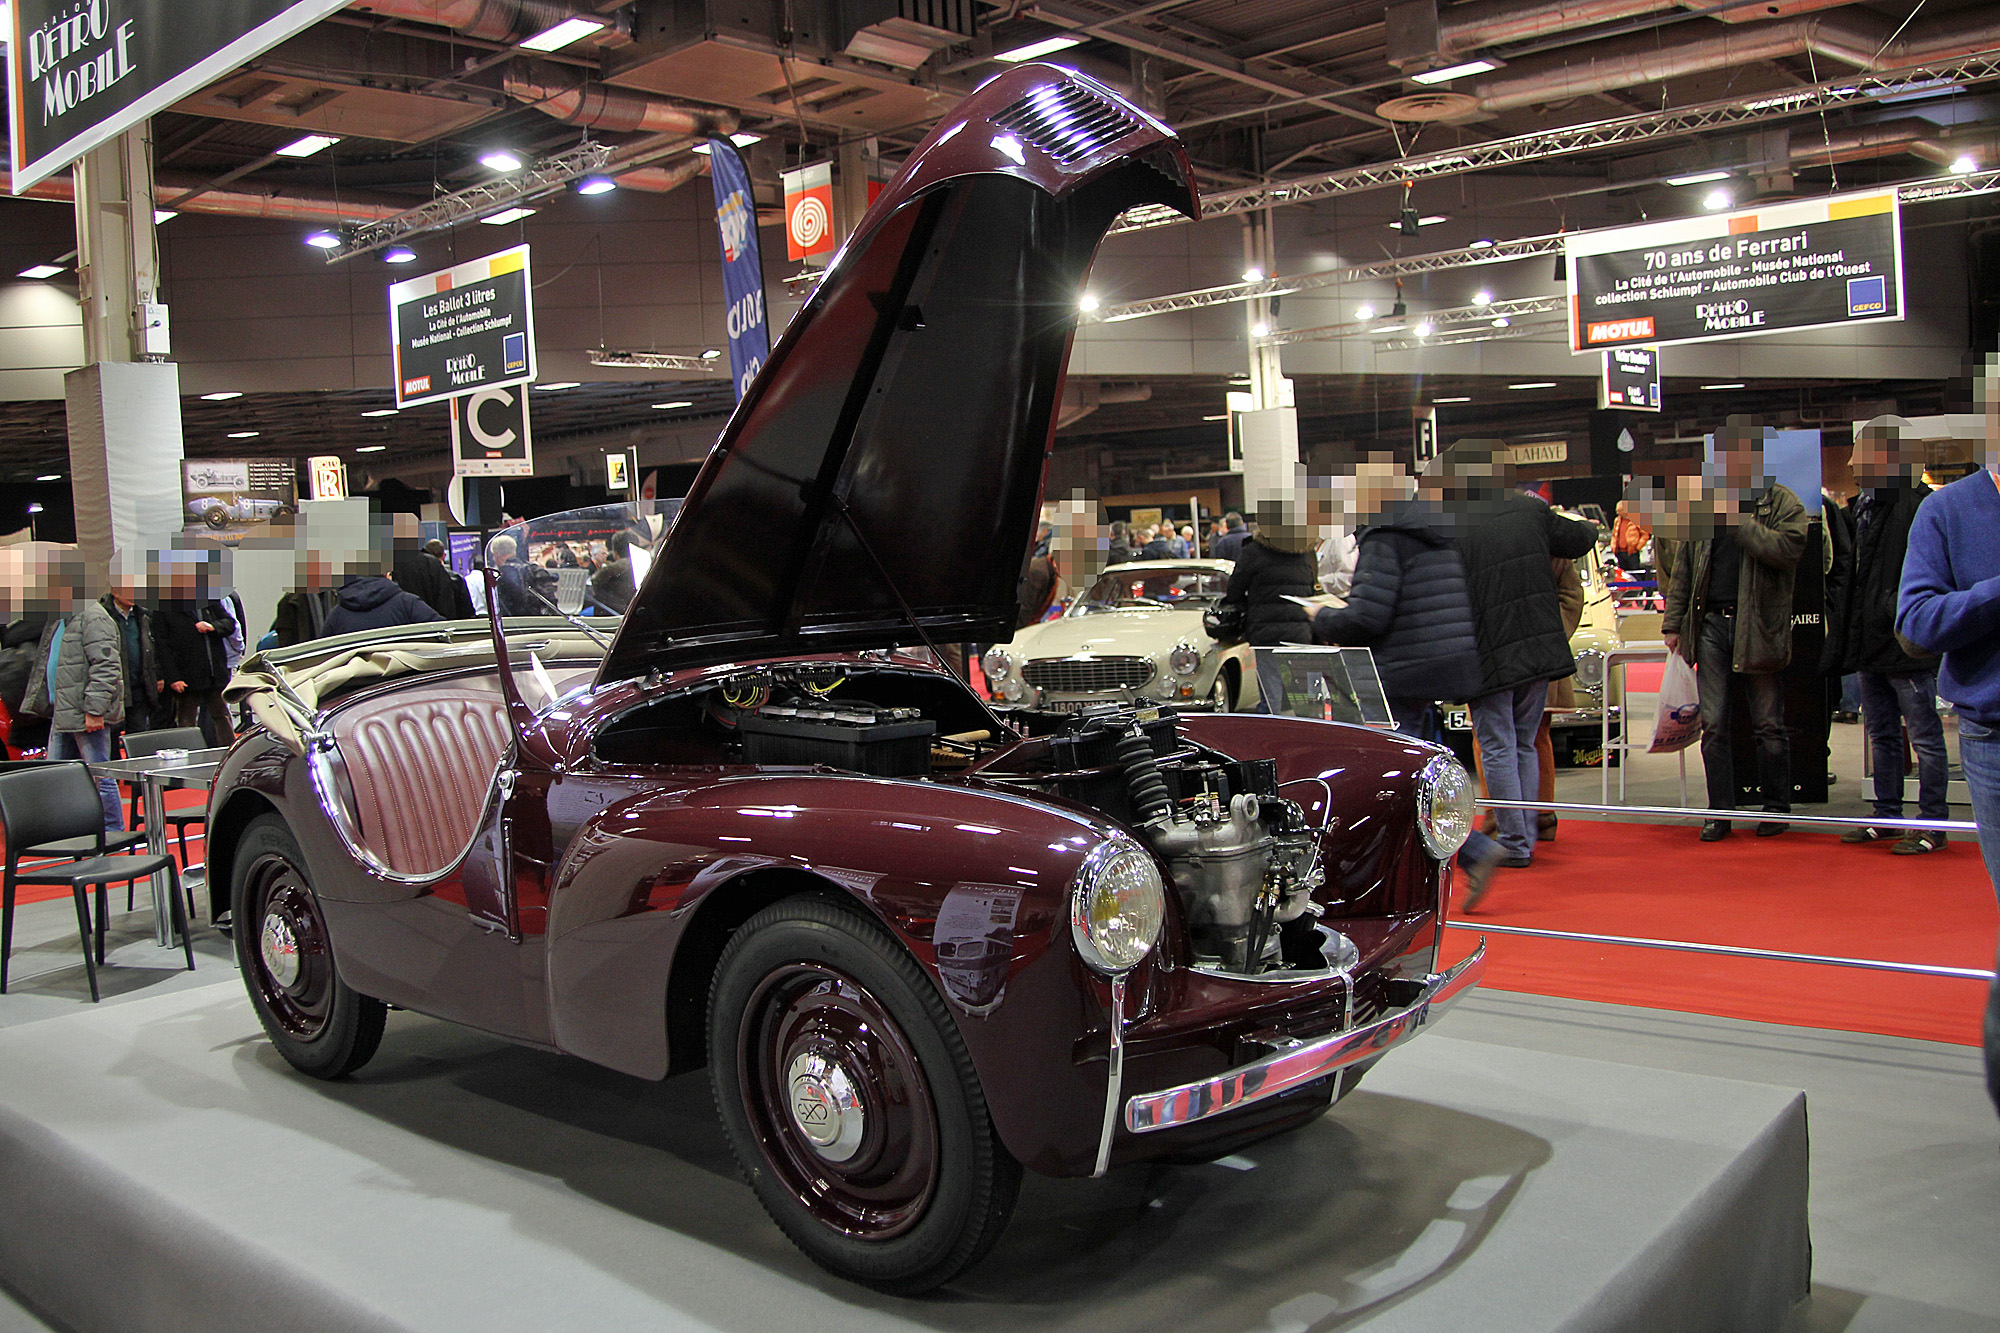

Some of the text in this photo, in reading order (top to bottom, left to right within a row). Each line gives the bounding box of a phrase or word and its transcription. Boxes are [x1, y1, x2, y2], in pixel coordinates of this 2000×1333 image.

[44, 19, 136, 127] MOBILE
[1644, 231, 1808, 271] 70 ans de Ferrari
[1595, 290, 1647, 305] collection
[1650, 282, 1702, 302] Schlumpf
[1712, 274, 1777, 292] Automobile
[1779, 268, 1808, 284] Club
[1810, 266, 1826, 279] de
[1827, 261, 1871, 278] l'Ouest
[1615, 279, 1629, 291] La
[1630, 275, 1652, 290] Cité
[1654, 273, 1668, 286] de
[1670, 264, 1741, 285] l'Automobile
[1752, 256, 1790, 273] Musée
[1792, 250, 1844, 267] National
[423, 288, 496, 319] Les Ballot 3 litres
[1852, 302, 1883, 312] GEFCO
[411, 336, 429, 349] Musée
[430, 330, 452, 345] National
[456, 323, 484, 338] Collection
[485, 314, 512, 332] Schlumpf
[429, 321, 436, 331] La
[437, 318, 447, 330] Cité
[448, 316, 455, 327] de
[1591, 320, 1652, 341] MOTUL
[1704, 311, 1766, 332] MOBILE
[405, 378, 430, 393] MOTUL
[467, 388, 516, 449] C
[1421, 422, 1430, 455] F
[1514, 445, 1562, 461] LAHAYE
[1743, 784, 1802, 793] VOO
